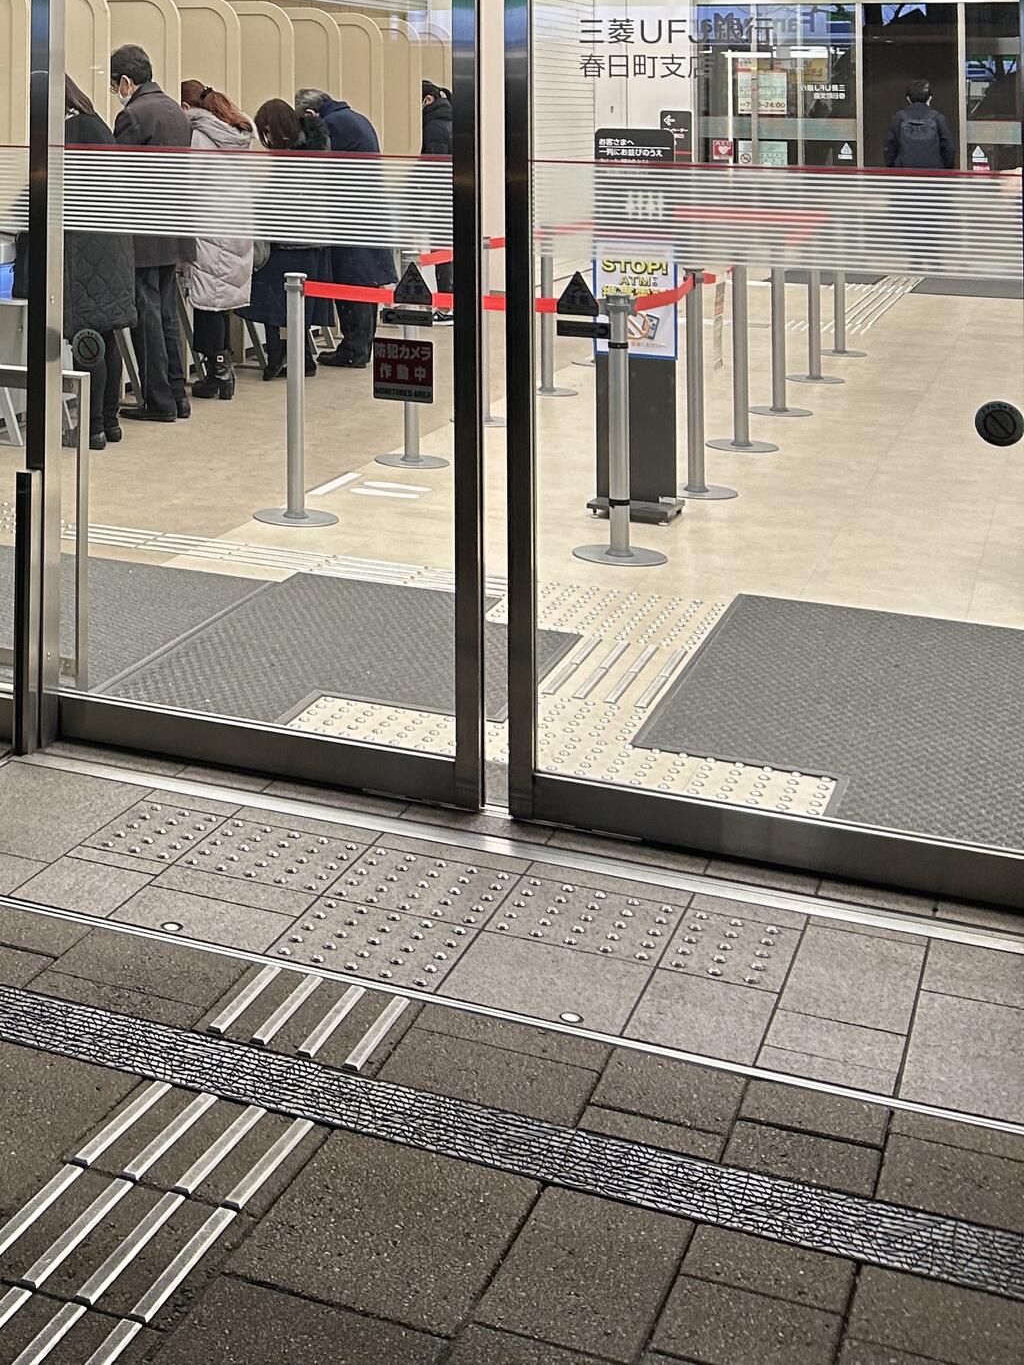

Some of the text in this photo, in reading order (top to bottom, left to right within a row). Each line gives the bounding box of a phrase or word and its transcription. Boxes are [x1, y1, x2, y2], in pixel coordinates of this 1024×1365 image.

[579, 54, 716, 80] 春日町支店
[598, 138, 635, 146] お客さまへ
[602, 258, 669, 276] STOP!
[375, 342, 432, 362] 防犯カメラ
[379, 362, 427, 382] 作動中
